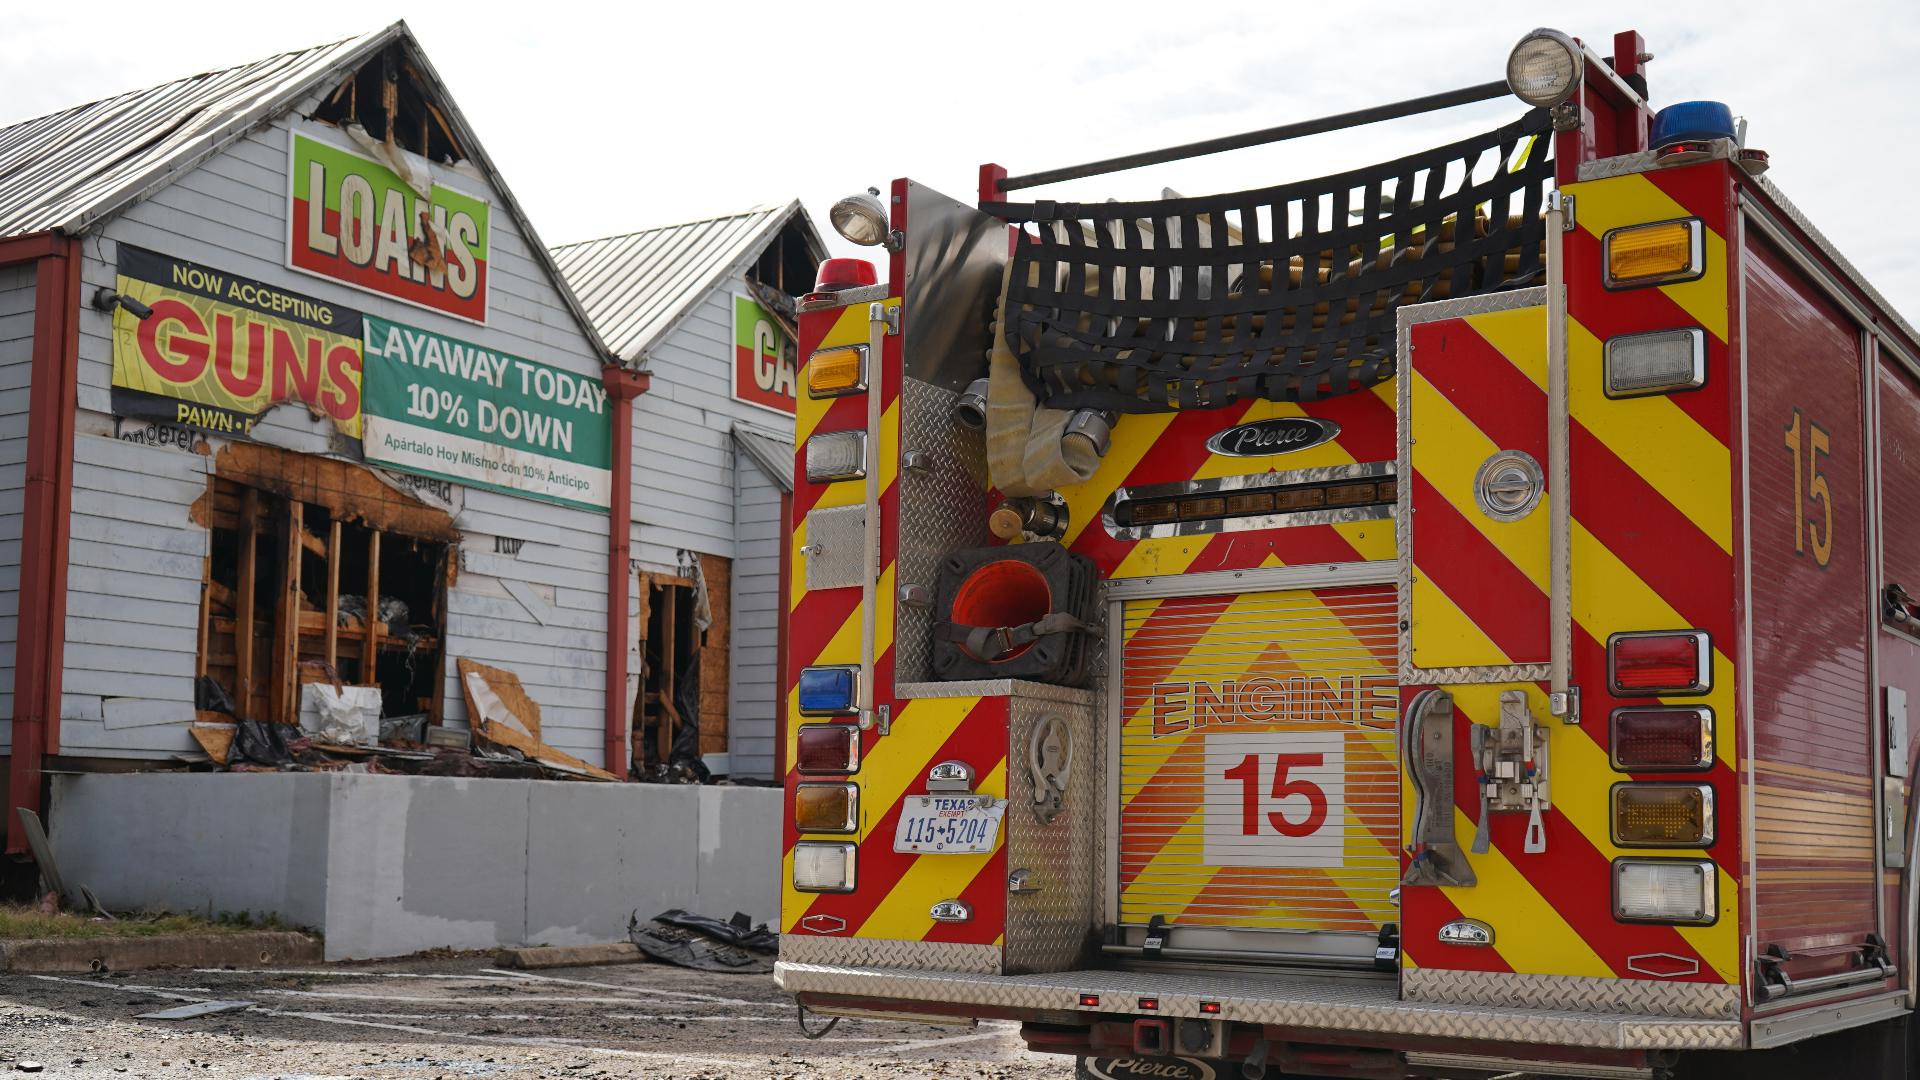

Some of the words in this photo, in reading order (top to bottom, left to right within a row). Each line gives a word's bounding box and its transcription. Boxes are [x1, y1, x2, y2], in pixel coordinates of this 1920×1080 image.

[308, 160, 480, 299] LOANS
[172, 263, 222, 295] NOW
[228, 281, 333, 325] ACCEPTING
[136, 296, 363, 421] GUNS
[362, 318, 509, 388] LAYAWAY
[515, 361, 608, 415] TODAY
[753, 319, 797, 399] CA
[177, 402, 233, 433] PAWN
[406, 383, 469, 428] 10%
[477, 399, 573, 453] DOWN
[1234, 427, 1308, 453] Pierce
[384, 433, 434, 457] Apártalo
[436, 446, 459, 467] Hoy
[461, 451, 499, 471] Mismo
[501, 463, 521, 476] con
[522, 465, 545, 481] 10%
[547, 470, 590, 491] Anticipo
[1784, 407, 1833, 570] 15
[1152, 675, 1399, 740] ENGINE
[934, 799, 976, 811] TEXAS
[938, 810, 966, 818] EXEMPT
[1224, 753, 1328, 838] 15
[1106, 1057, 1190, 1079] Pierce
